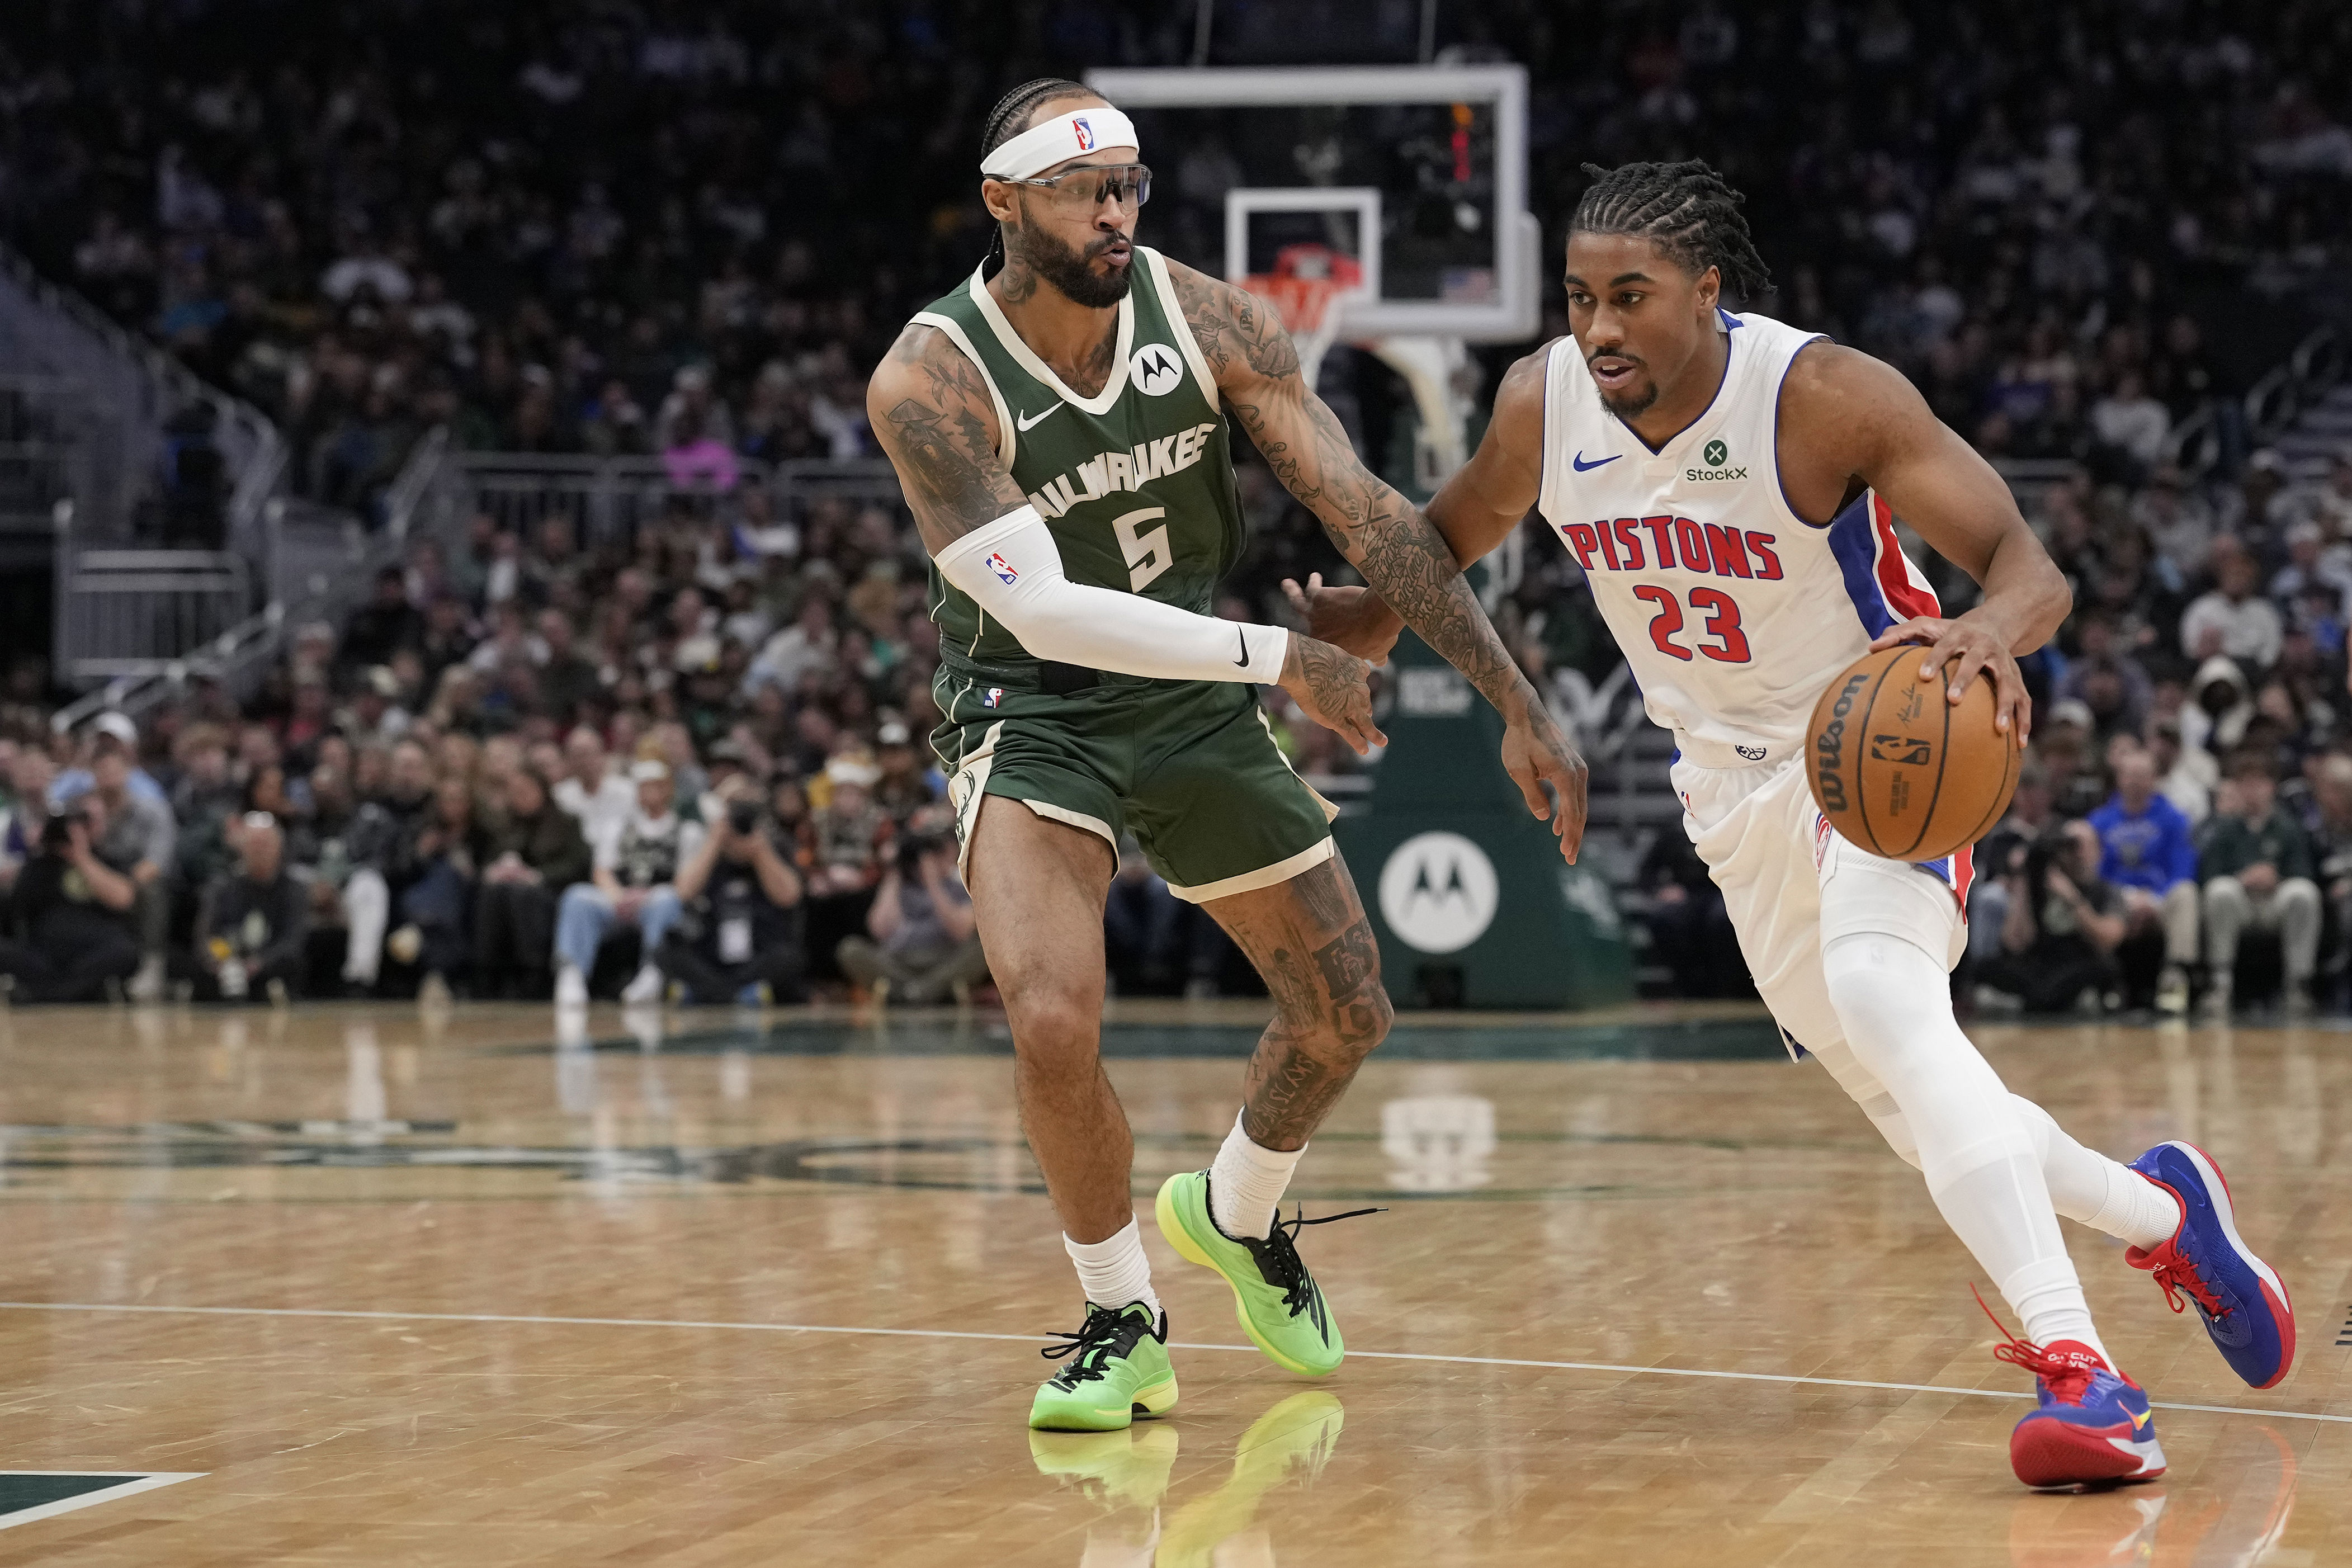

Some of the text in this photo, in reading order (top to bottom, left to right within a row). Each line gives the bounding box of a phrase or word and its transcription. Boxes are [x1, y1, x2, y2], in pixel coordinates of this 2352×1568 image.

[1686, 466, 1748, 481] StockX
[1111, 507, 1173, 594] 5
[1561, 514, 1784, 581] PISTONS
[1632, 584, 1752, 664] 23
[1817, 673, 1870, 814] Wilson
